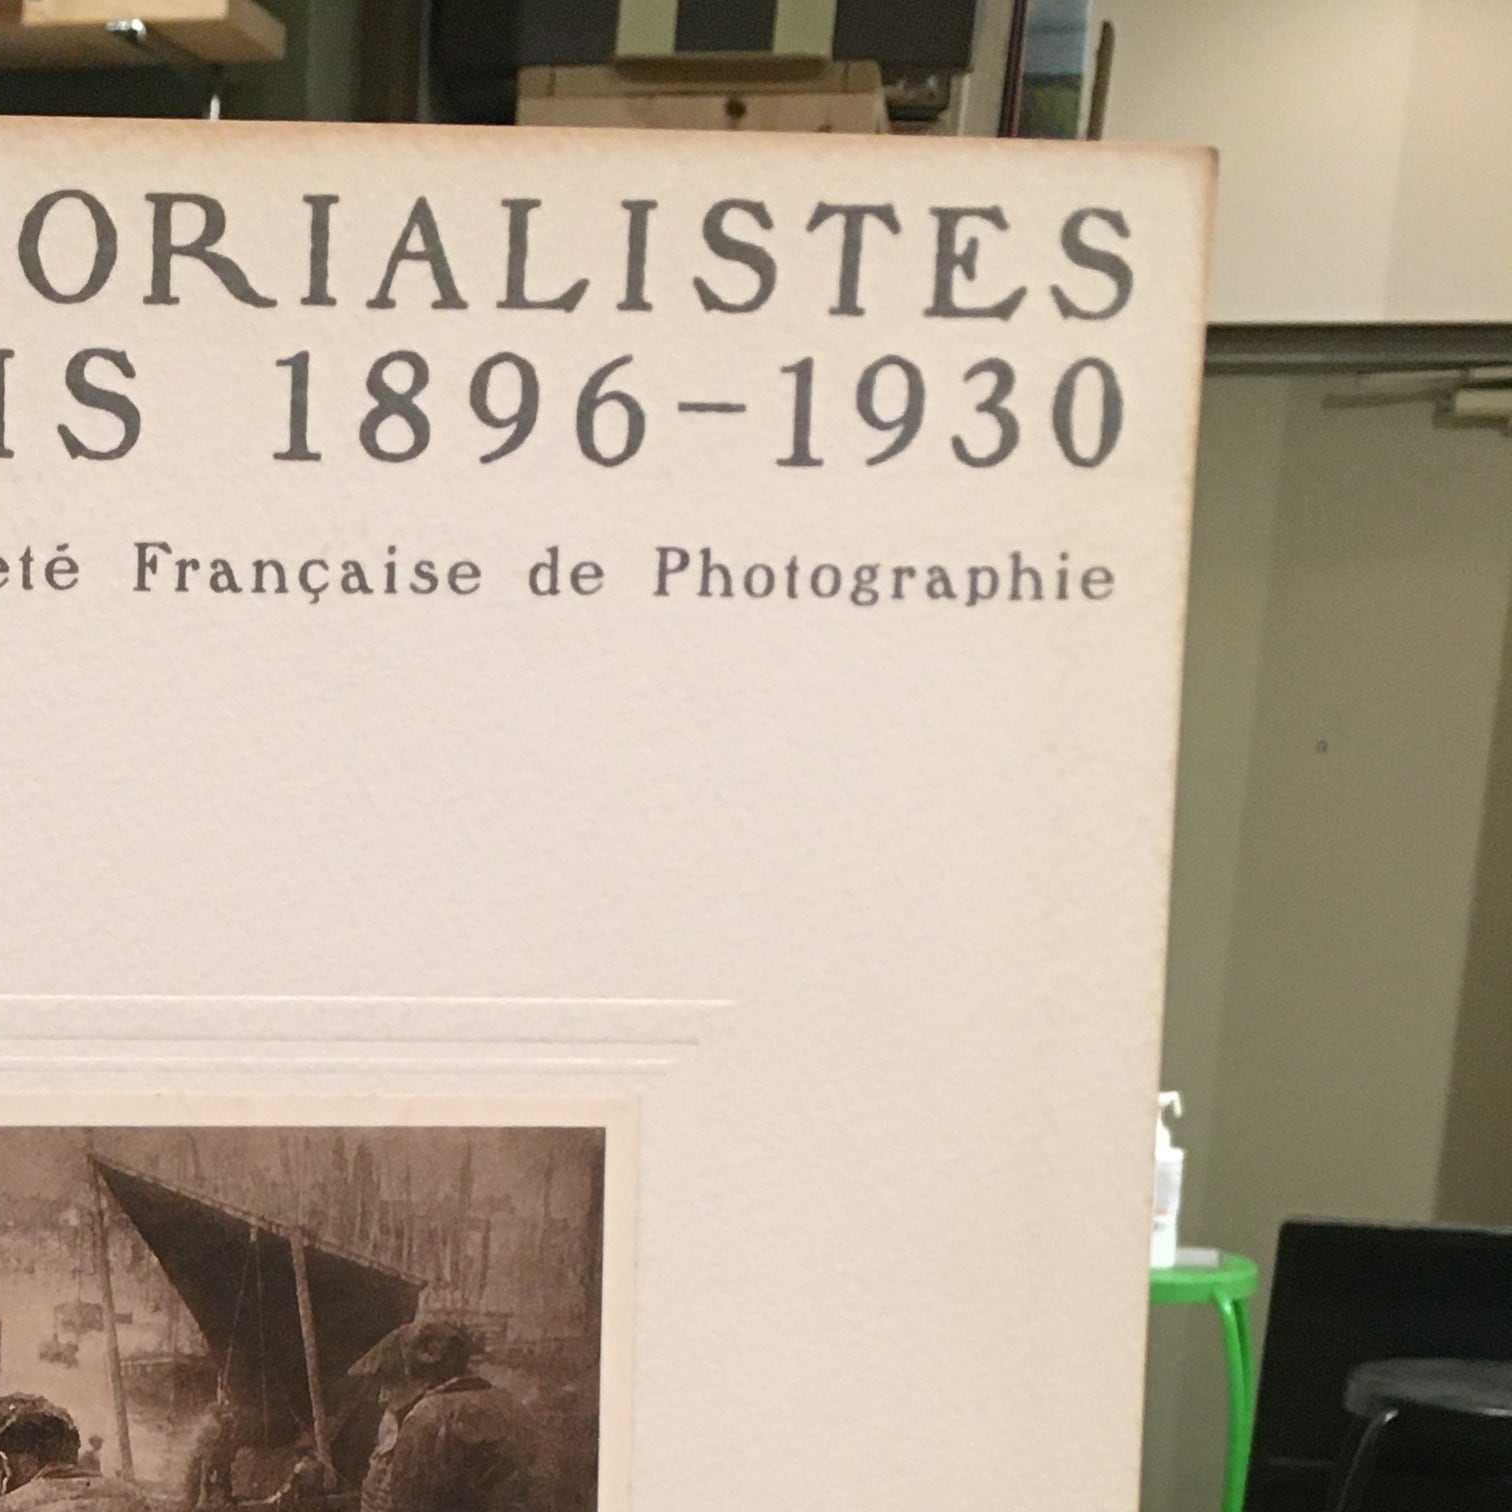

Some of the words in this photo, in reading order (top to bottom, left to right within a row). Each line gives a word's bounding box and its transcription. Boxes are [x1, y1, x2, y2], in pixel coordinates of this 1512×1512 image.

[134, 542, 481, 604] Française
[529, 546, 603, 596] de
[655, 547, 1113, 606] Photographie
